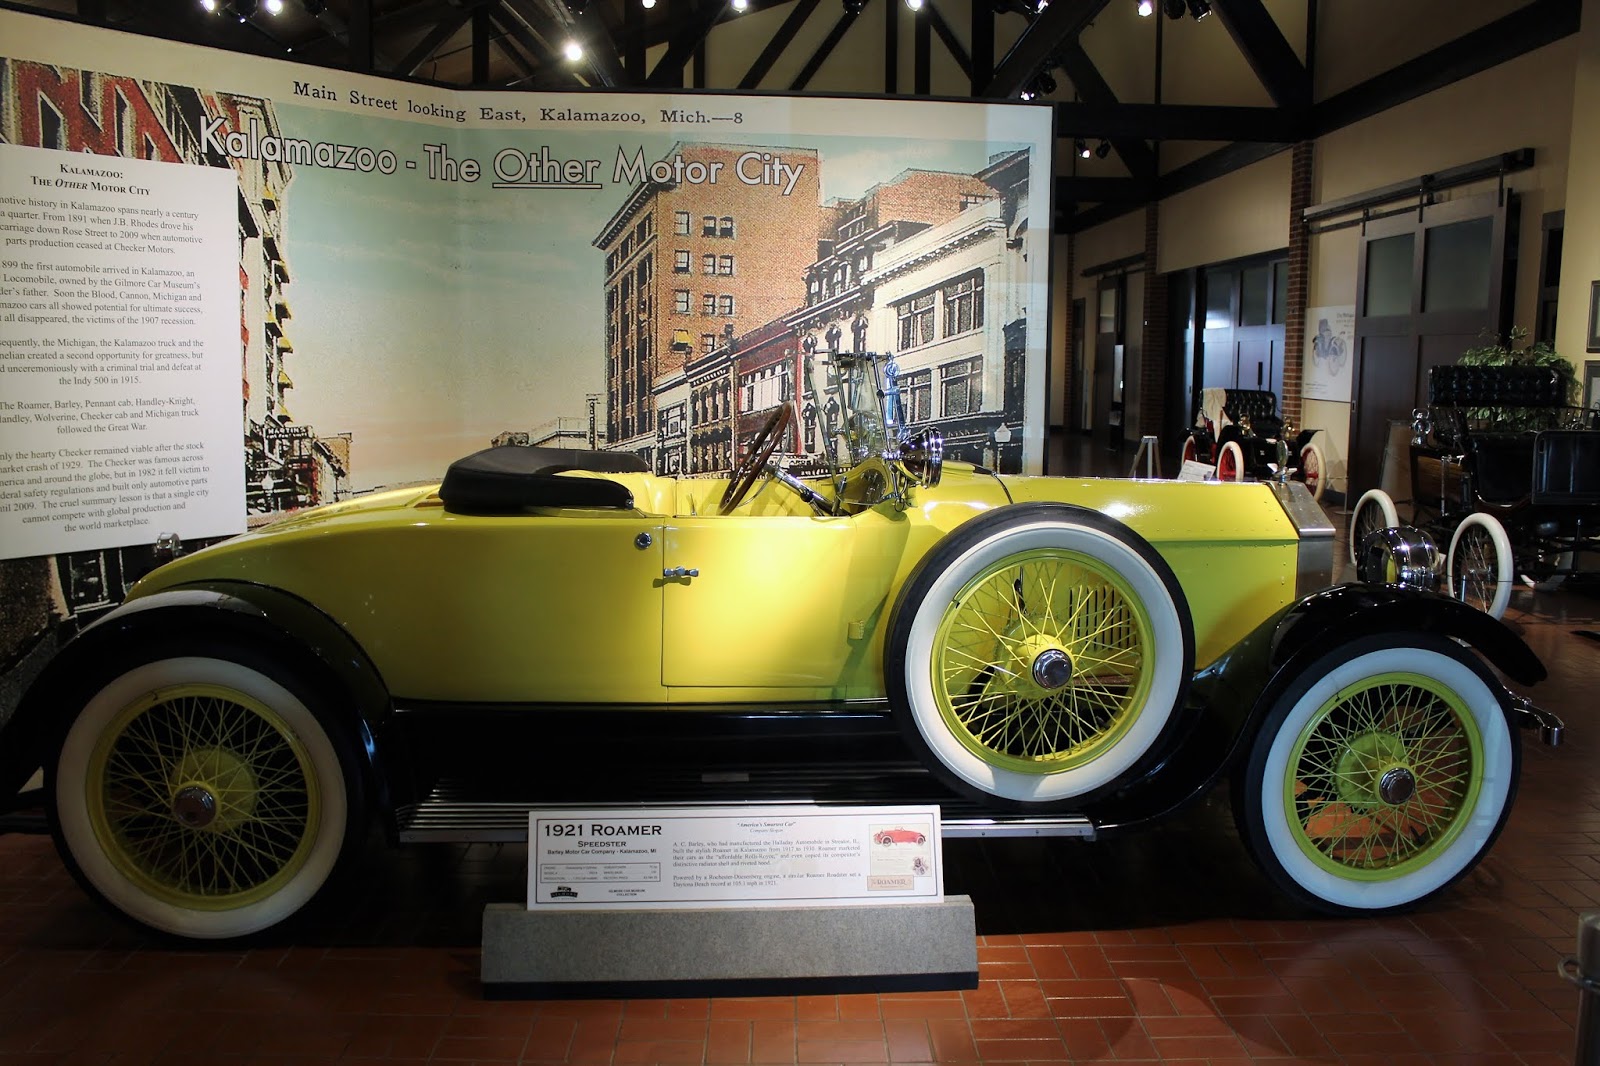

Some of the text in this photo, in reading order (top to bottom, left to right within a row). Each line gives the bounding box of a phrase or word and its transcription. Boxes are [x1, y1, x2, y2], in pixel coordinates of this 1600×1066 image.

[293, 81, 337, 102] Main
[350, 91, 398, 111] Street
[408, 100, 466, 122] looking
[480, 108, 526, 123] East,
[541, 108, 646, 125] Kalamazoo,
[200, 116, 396, 175] Kalamazoo
[424, 144, 480, 182] The
[493, 146, 601, 184] Other
[613, 145, 724, 185] Motor
[736, 152, 805, 196] City
[60, 165, 123, 180] KALAMAZOO:
[32, 177, 150, 196] THE OTHER MOTOR CITY
[28, 199, 199, 222] history Kalamazoo spans nearly century
[7, 211, 159, 229] quarter. From 1891 J.B. Rhodes
[0, 226, 202, 243] carriage down Street 2009 automotive
[5, 238, 176, 254] parts production ceased Checker Motors.
[36, 262, 185, 277] first automobile arrived Kalamazoo,
[4, 275, 200, 289] Locomobile, owned Gilmore Car Museum's
[22, 289, 187, 303] father. Soon Blood, Cannon, Michigan
[61, 303, 92, 312] showed
[94, 304, 128, 314] potential
[142, 304, 173, 313] ultimate
[17, 315, 70, 325] disappeared,
[86, 316, 116, 324] victims
[141, 317, 159, 325] 1907
[57, 339, 177, 349] Michigan, Kalamazoo truck
[27, 352, 191, 362] created second opportunity greatness,
[6, 363, 194, 374] unceremoniously criminal defeat
[73, 376, 92, 386] Indy
[94, 376, 109, 384] 500
[0, 397, 196, 410] The Roamer, Barley, Pennant Handley-Knight,
[34, 409, 199, 423] Wolverine, Checker Michigan truck
[57, 423, 148, 434] followed Great War.
[30, 442, 205, 461] hearty Checker remained viable after stock
[26, 463, 48, 472] crash
[89, 460, 102, 468] The
[104, 458, 136, 468] Checker
[154, 455, 180, 465] famous
[44, 465, 201, 484] around globe, 1982 victim
[23, 477, 208, 500] safety regulations built automotive parts
[41, 500, 58, 509] The
[59, 499, 80, 508] cruel
[80, 498, 118, 508] summary
[119, 494, 142, 503] lesson
[173, 490, 195, 501] single
[195, 489, 210, 500] city
[22, 503, 172, 524] cannot compete global production
[78, 518, 150, 531] world marketplace.
[545, 824, 662, 837] 1921 ROAMER
